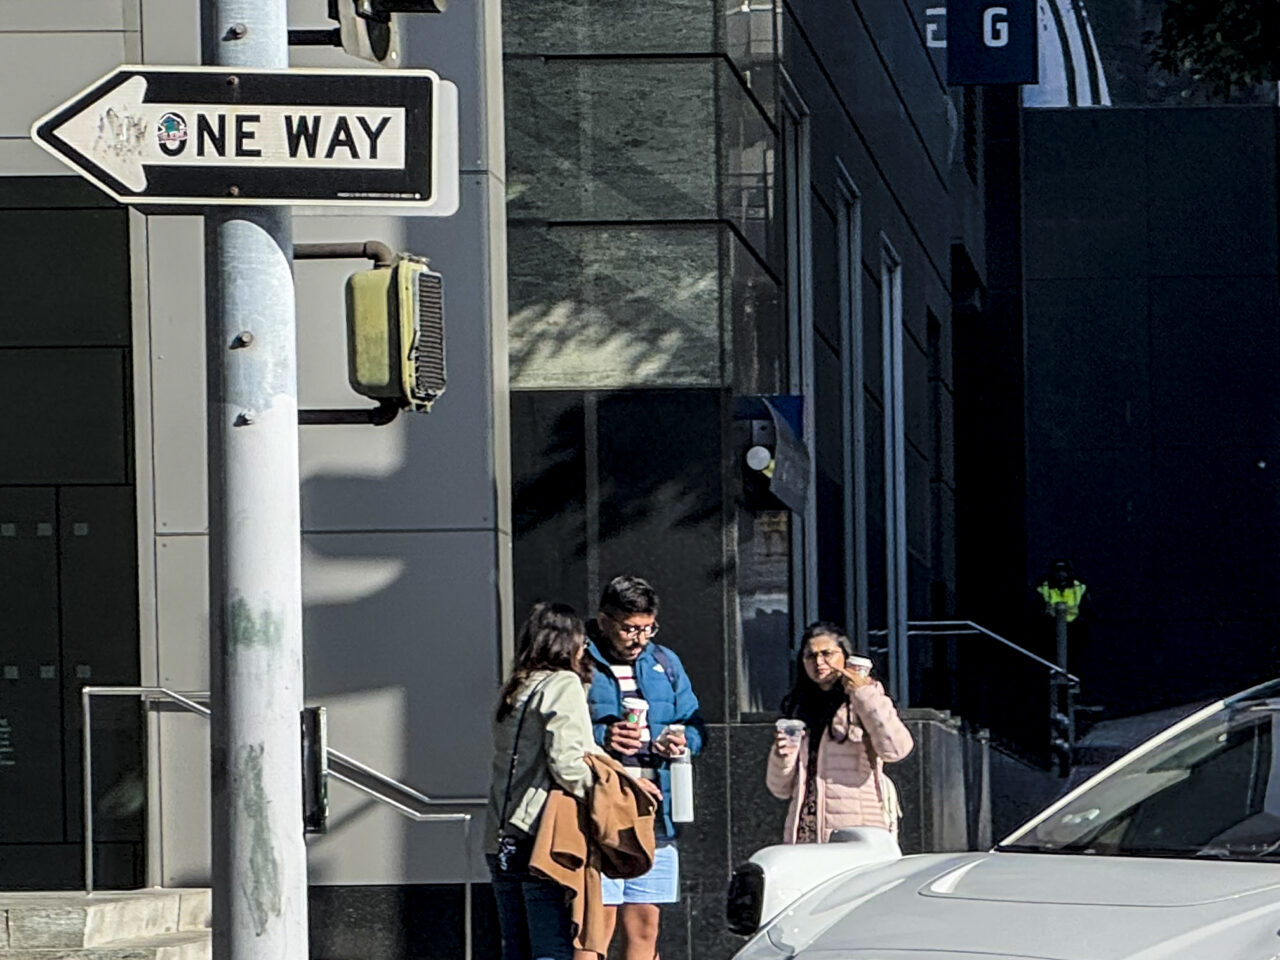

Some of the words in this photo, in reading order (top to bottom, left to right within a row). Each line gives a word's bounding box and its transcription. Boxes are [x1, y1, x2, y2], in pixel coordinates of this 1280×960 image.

[983, 7, 1009, 47] G
[157, 112, 262, 157] ONE
[283, 114, 393, 159] WAY
